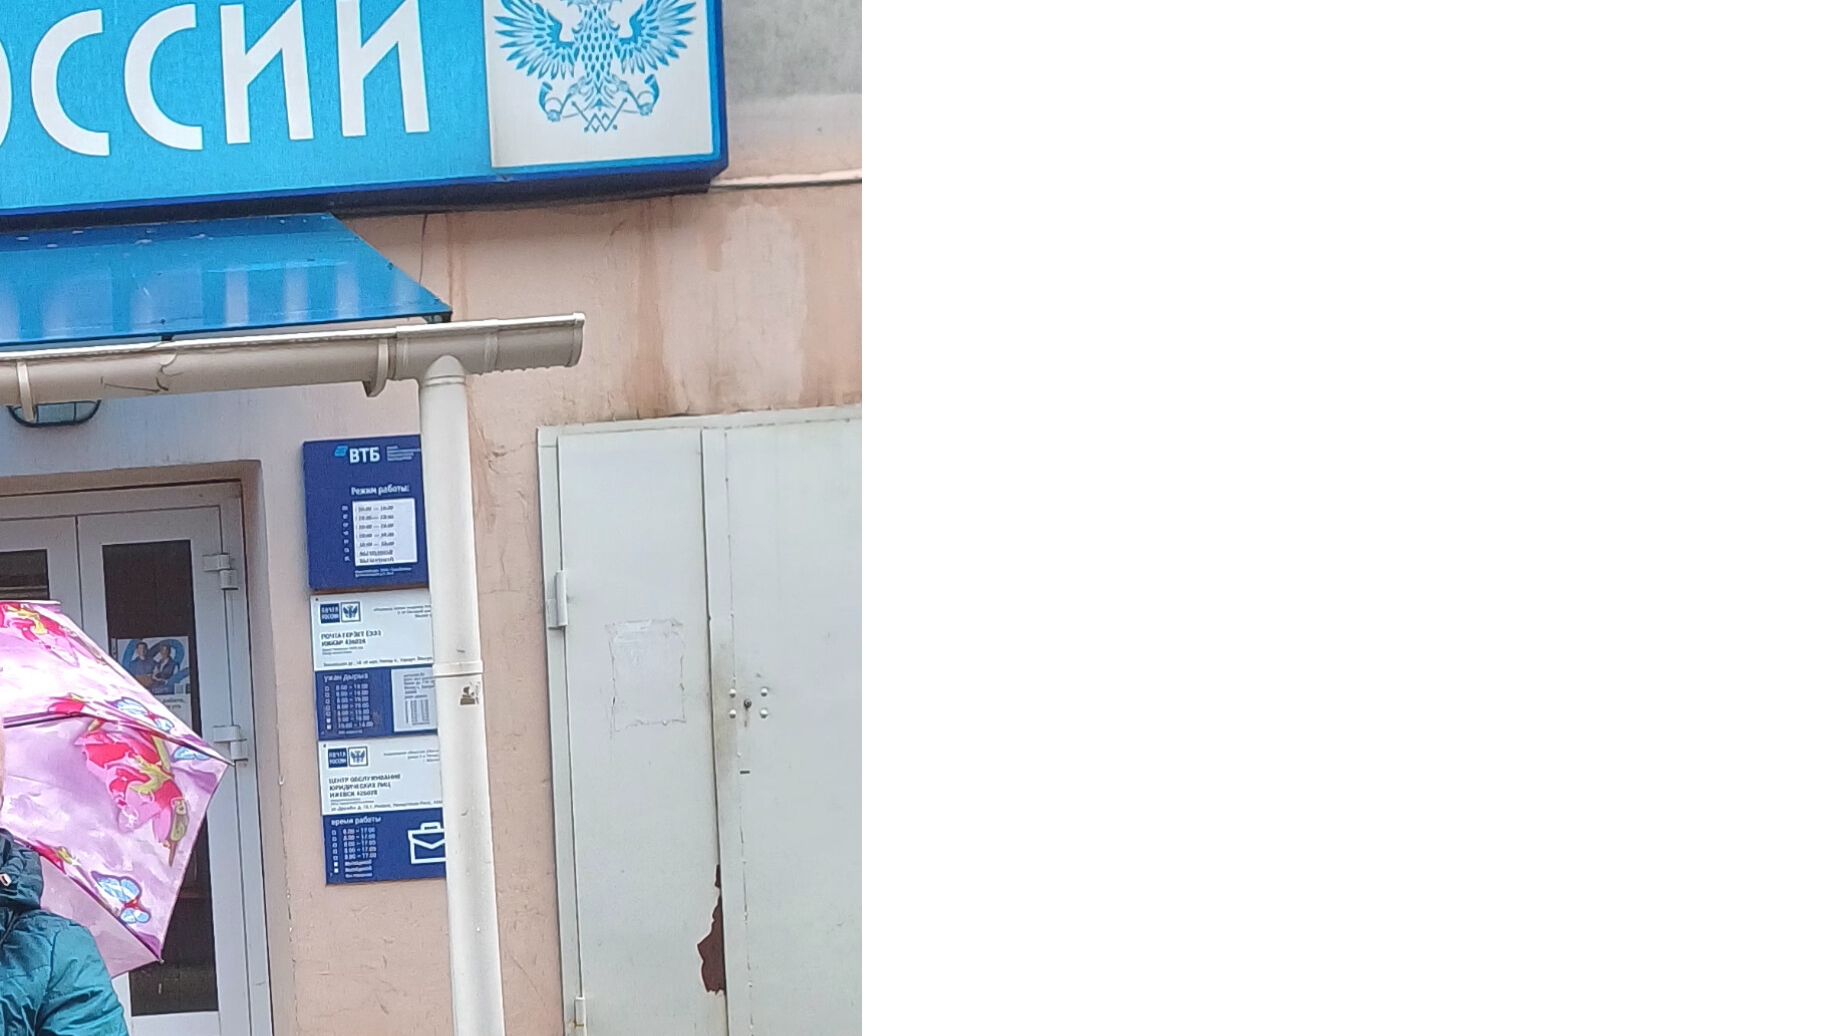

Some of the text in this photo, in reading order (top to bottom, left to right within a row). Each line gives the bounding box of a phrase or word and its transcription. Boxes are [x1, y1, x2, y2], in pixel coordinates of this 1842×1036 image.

[349, 446, 381, 464] ВТБ
[331, 815, 382, 827] время работы
